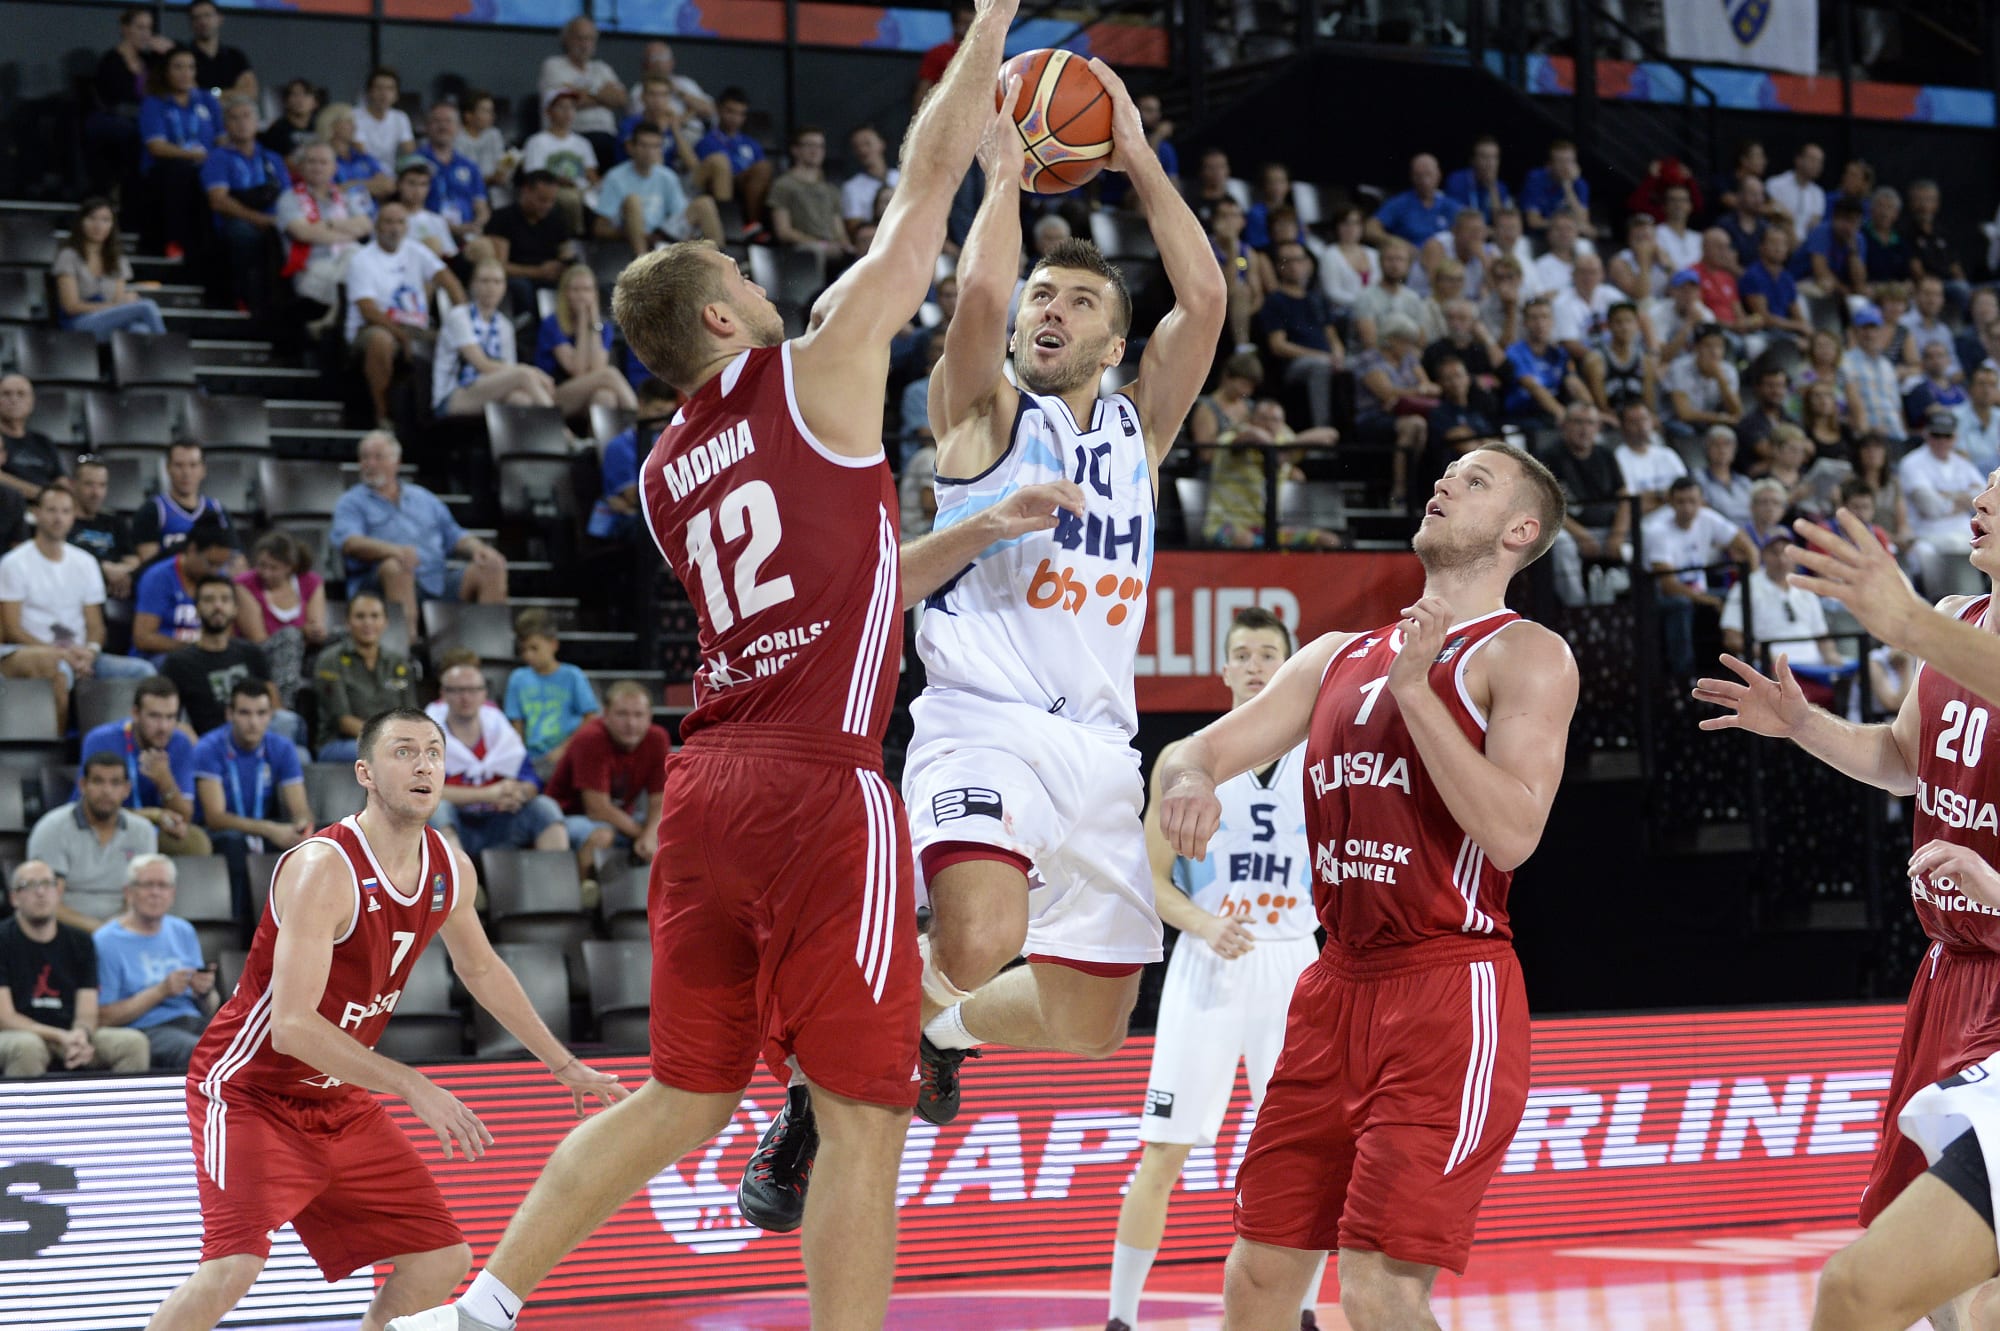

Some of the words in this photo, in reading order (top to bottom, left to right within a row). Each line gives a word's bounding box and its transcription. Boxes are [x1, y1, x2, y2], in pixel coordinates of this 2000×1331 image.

[662, 419, 756, 503] MONIA
[1073, 441, 1113, 501] 10
[684, 479, 796, 636] 12
[1053, 505, 1142, 569] BIH
[1026, 558, 1088, 617] bh
[742, 620, 832, 659] NORILS
[1935, 699, 1989, 768] 20
[1309, 751, 1412, 800] RUSSIA
[1249, 803, 1279, 842] 5
[1229, 852, 1292, 889] BIH
[391, 930, 416, 978] 7
